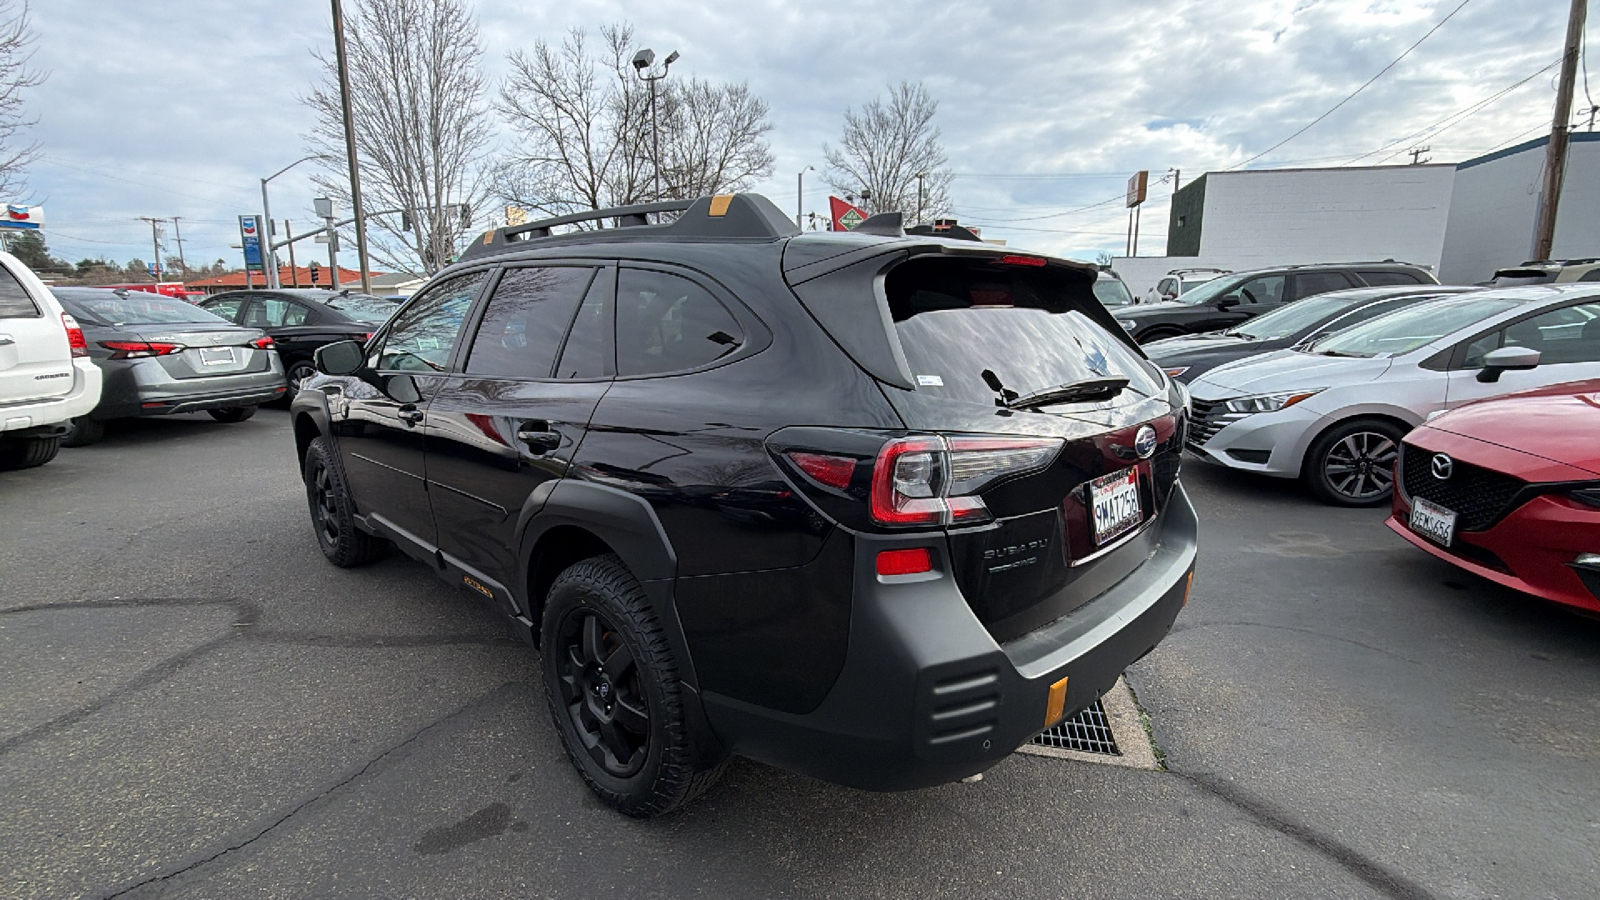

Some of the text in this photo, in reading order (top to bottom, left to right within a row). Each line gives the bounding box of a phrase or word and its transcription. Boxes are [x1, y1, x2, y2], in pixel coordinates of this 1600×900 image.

[1094, 488, 1138, 533] 9MAT258
[1412, 510, 1451, 539] 9EMS656
[983, 538, 1048, 559] SUBARU
